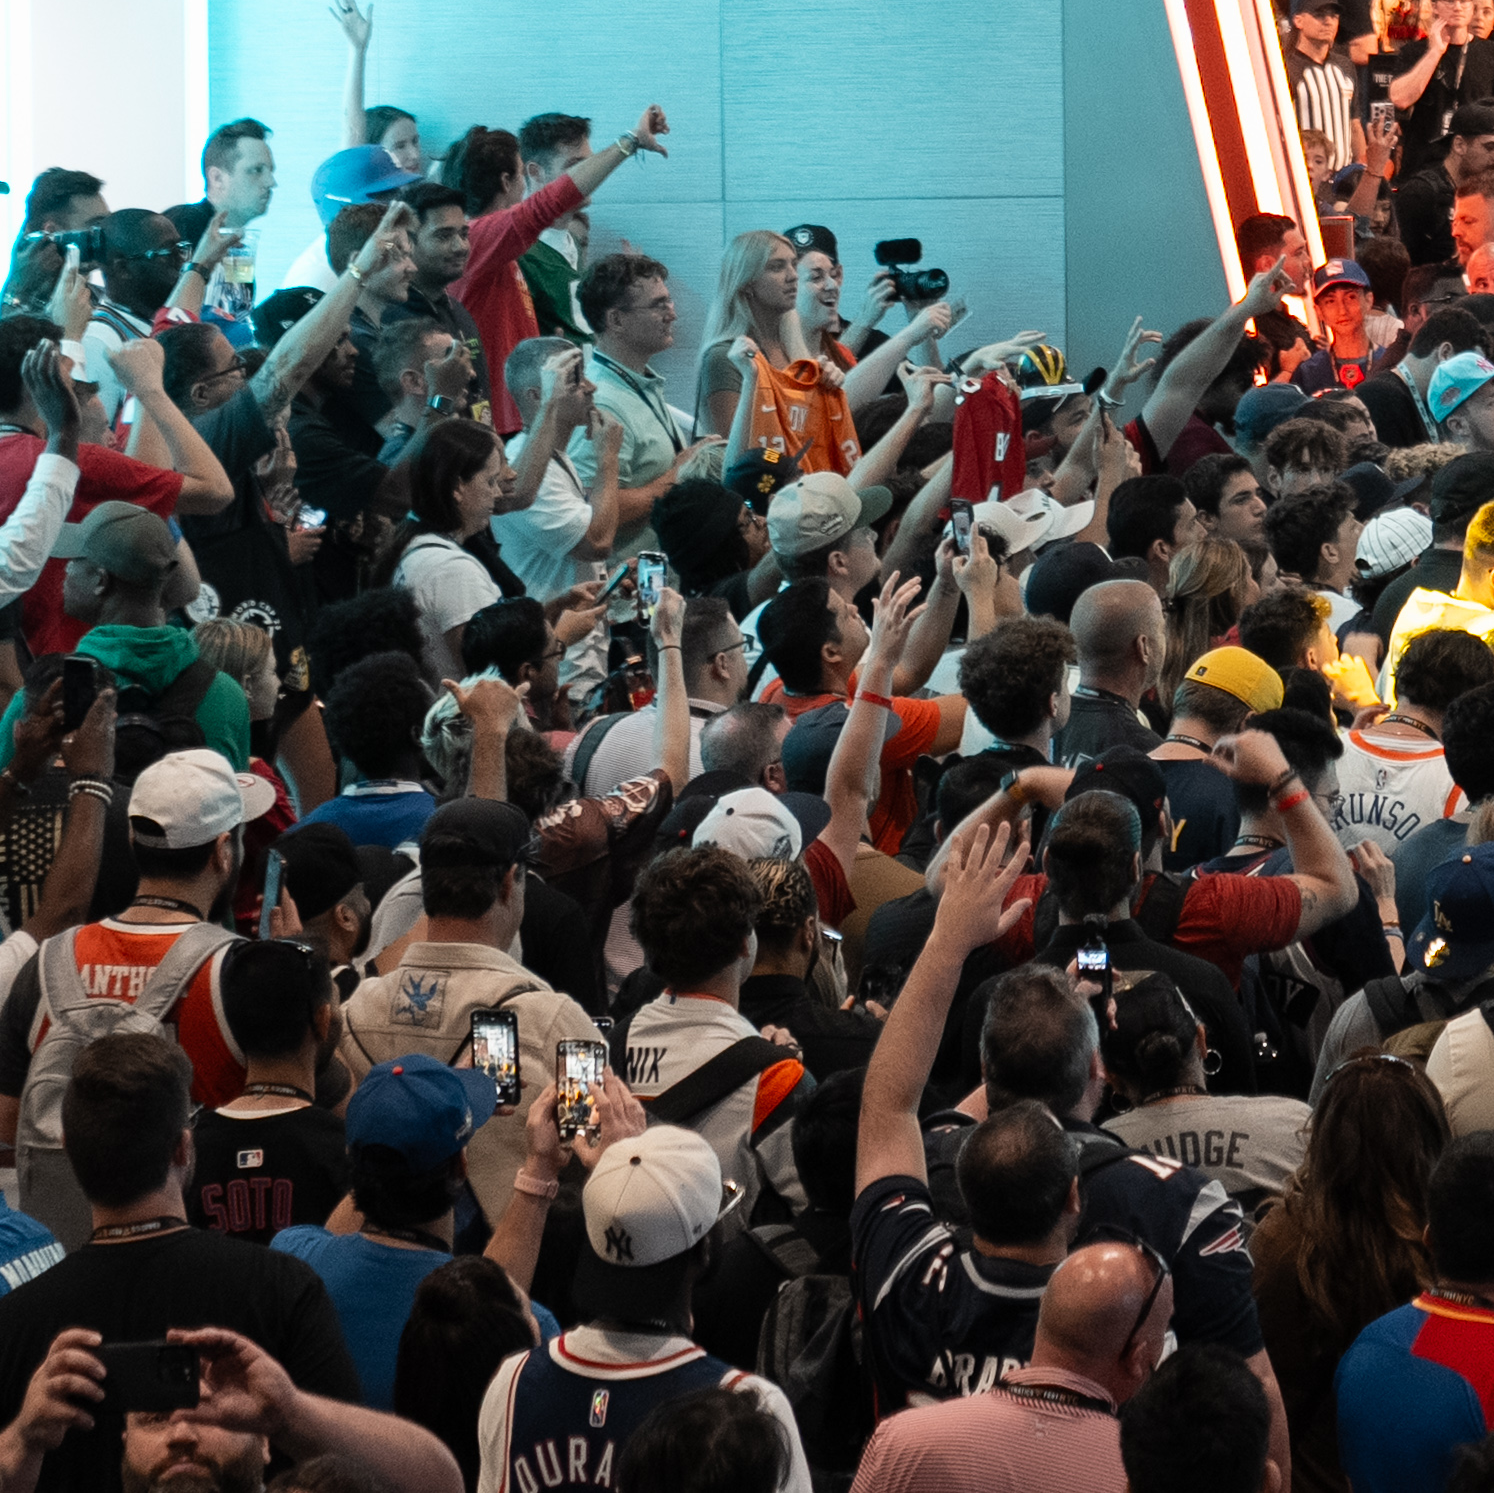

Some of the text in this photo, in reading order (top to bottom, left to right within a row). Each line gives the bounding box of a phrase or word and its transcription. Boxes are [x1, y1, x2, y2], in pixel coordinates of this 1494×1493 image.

[81, 963, 157, 997] ANTH
[626, 1046, 667, 1084] NIX
[1153, 1130, 1249, 1169] UDGE
[202, 1177, 294, 1235] SOTO
[604, 1226, 635, 1262] NY
[926, 1349, 1032, 1398] BRAD
[515, 1435, 616, 1493] DURA
